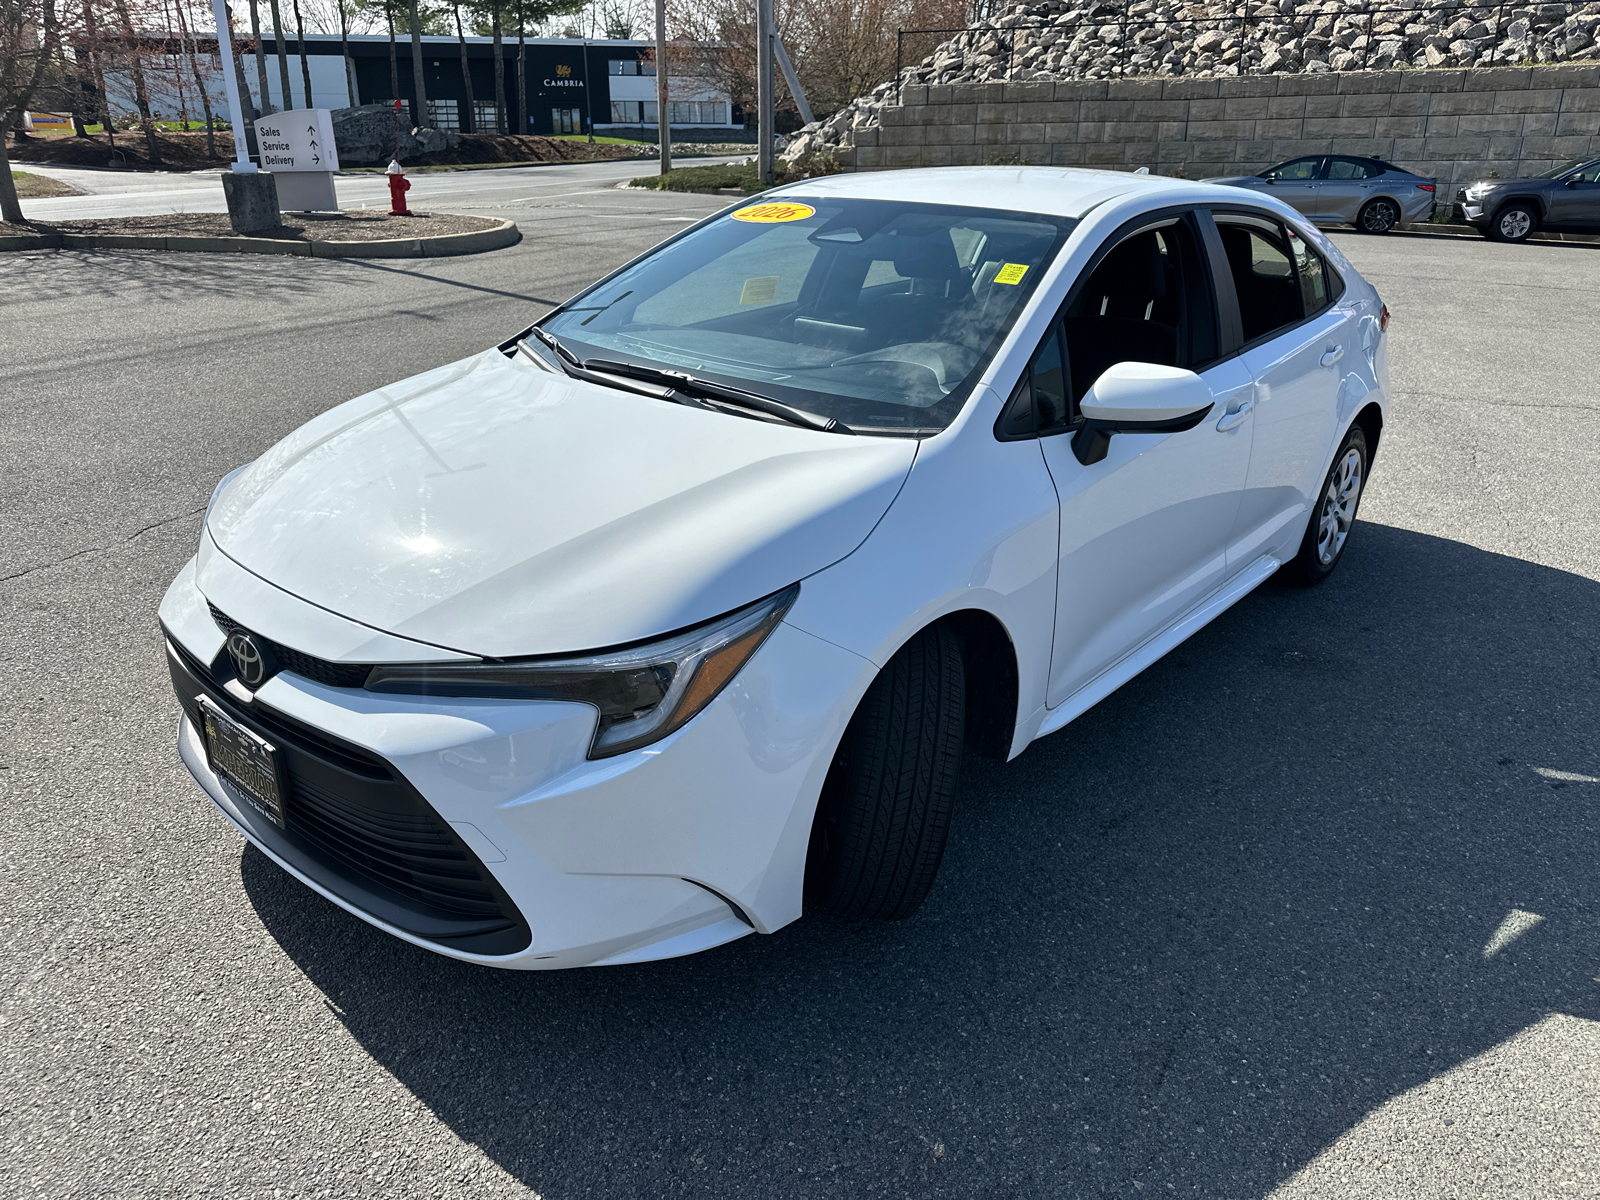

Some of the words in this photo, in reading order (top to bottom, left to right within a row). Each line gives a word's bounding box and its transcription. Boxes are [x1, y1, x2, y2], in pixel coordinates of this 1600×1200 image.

[543, 78, 584, 87] CAMBRIA
[260, 127, 281, 137] Sales
[262, 141, 290, 151] Service
[265, 155, 294, 167] Delivery
[738, 206, 807, 219] 2026
[209, 735, 279, 806] IMPERIAL
[213, 757, 280, 812] www.imperialcars.com
